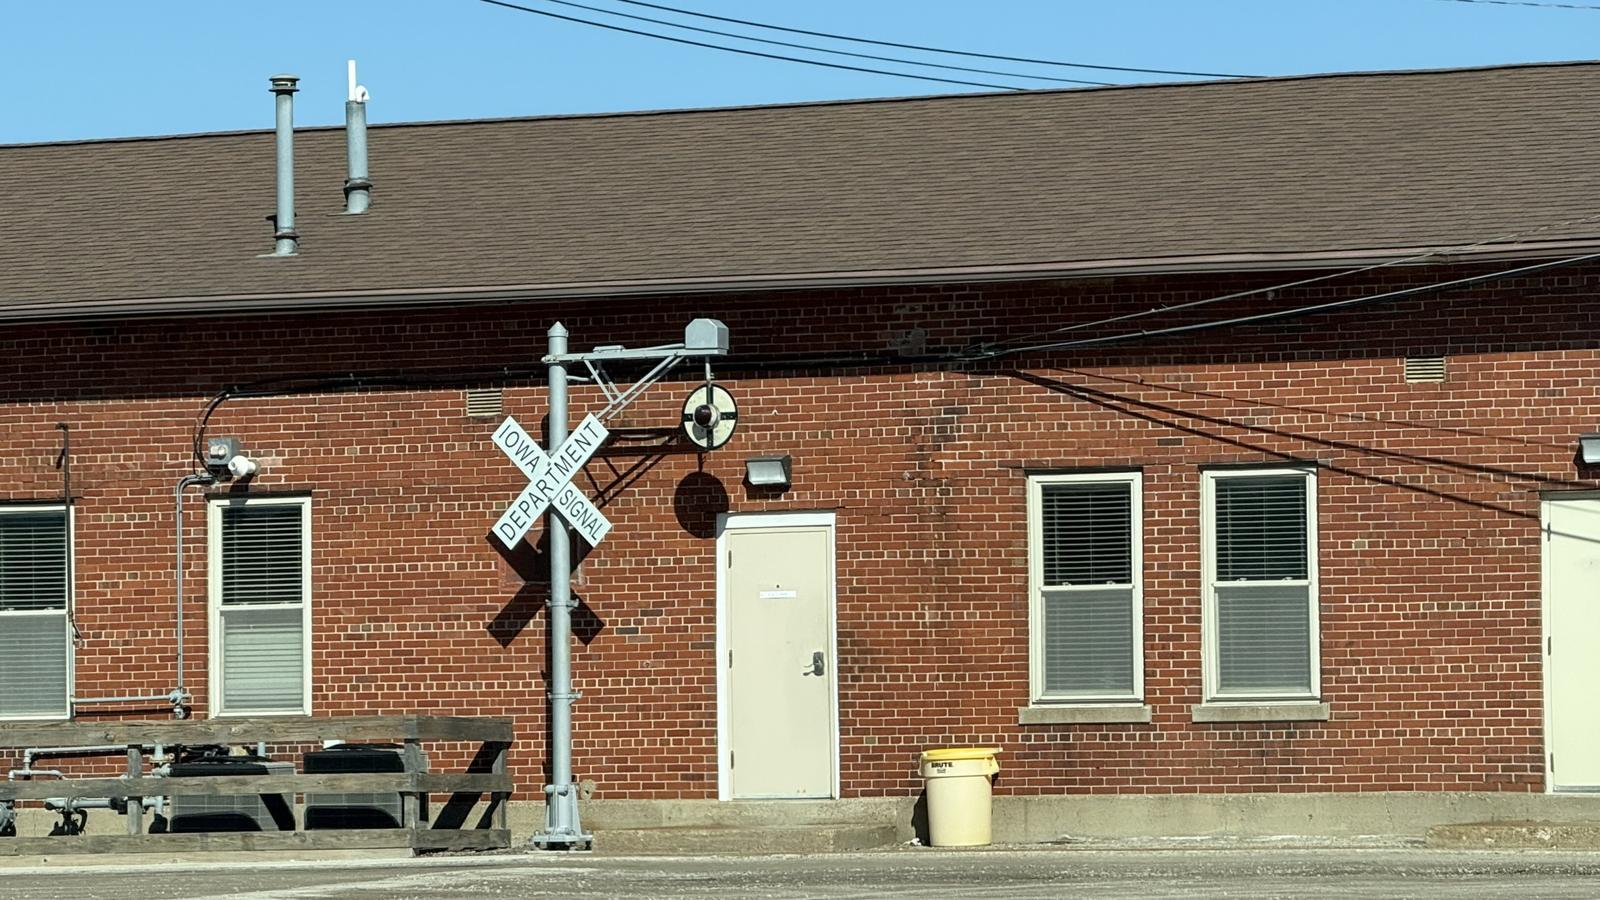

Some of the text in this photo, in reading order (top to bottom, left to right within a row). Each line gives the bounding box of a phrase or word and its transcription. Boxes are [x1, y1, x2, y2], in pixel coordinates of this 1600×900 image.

[498, 424, 541, 473] IOWA
[499, 421, 599, 541] DEPARTMENT
[559, 489, 604, 541] SIGNAL
